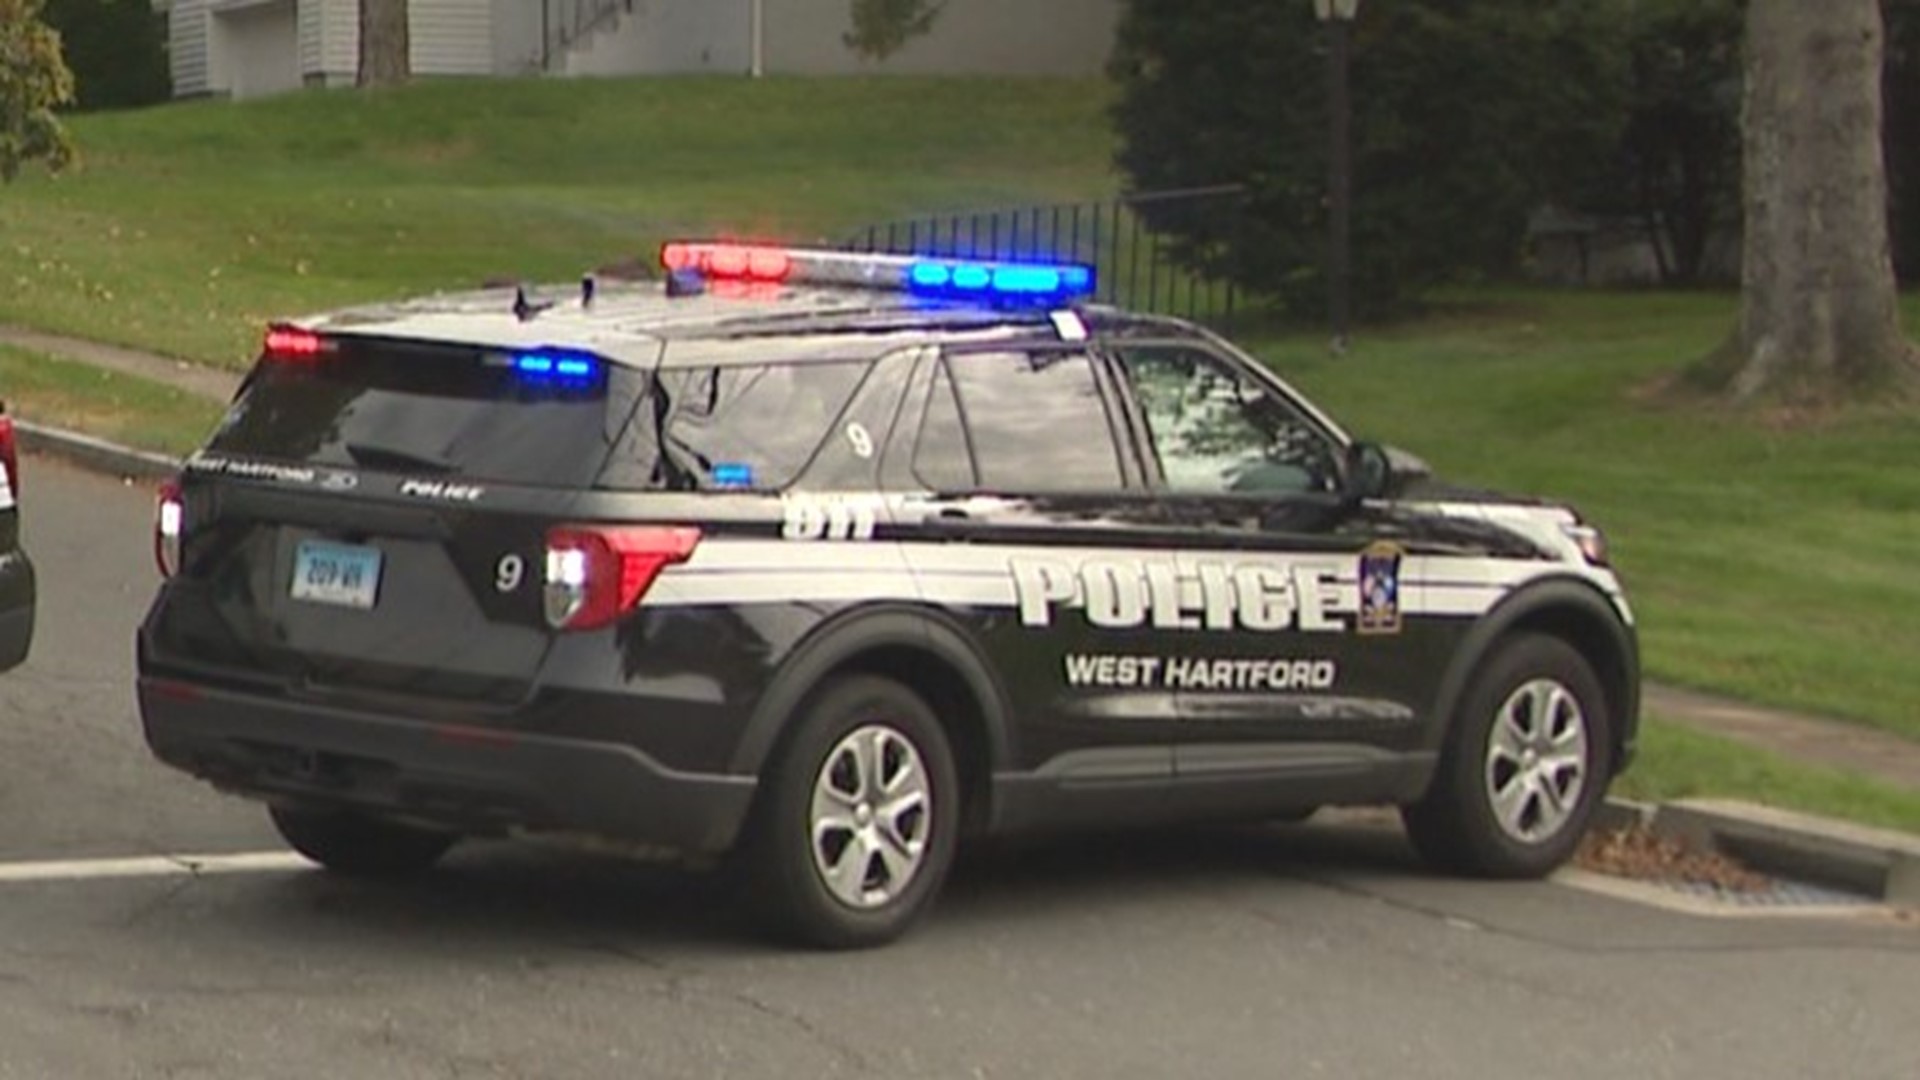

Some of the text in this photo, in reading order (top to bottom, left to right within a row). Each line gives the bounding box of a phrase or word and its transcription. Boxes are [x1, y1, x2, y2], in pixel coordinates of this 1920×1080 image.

[847, 422, 873, 459] 9
[401, 480, 486, 502] POLICE
[496, 554, 524, 593] 9
[1010, 556, 1347, 632] POLICE
[1065, 655, 1336, 690] WEST HARTFORD
